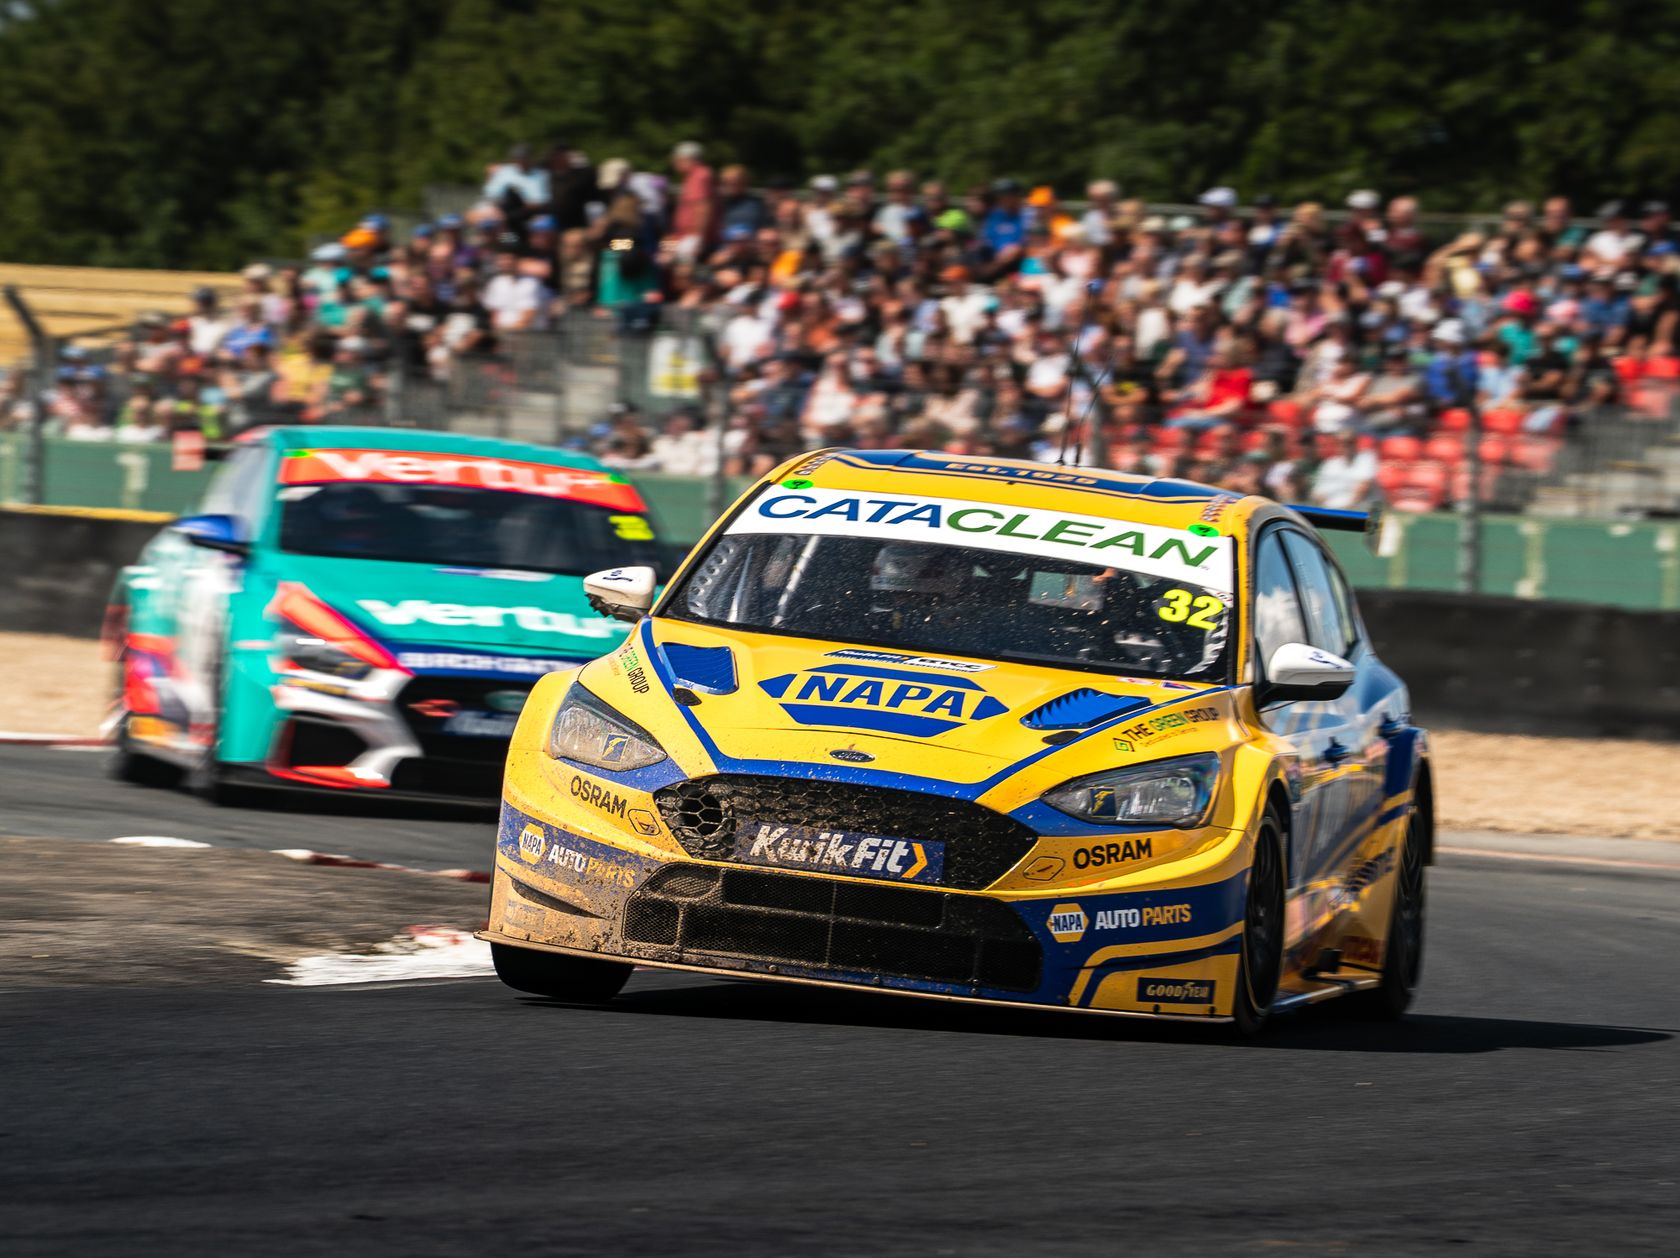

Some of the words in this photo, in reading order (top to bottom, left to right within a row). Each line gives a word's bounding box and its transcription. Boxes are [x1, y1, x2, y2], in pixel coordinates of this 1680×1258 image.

[758, 495, 1219, 567] CATACLEAN
[1158, 588, 1223, 630] 32
[627, 667, 650, 694] GROUP
[795, 675, 967, 718] NAPA
[1121, 723, 1155, 742] THE
[570, 775, 627, 819] OSRAM
[521, 830, 543, 856] NAPA
[548, 843, 586, 873] AUTO
[1072, 837, 1153, 870] OSRAM
[1053, 913, 1084, 932] NAPA
[1094, 908, 1140, 930] AUTO
[1142, 903, 1192, 927] PARTS
